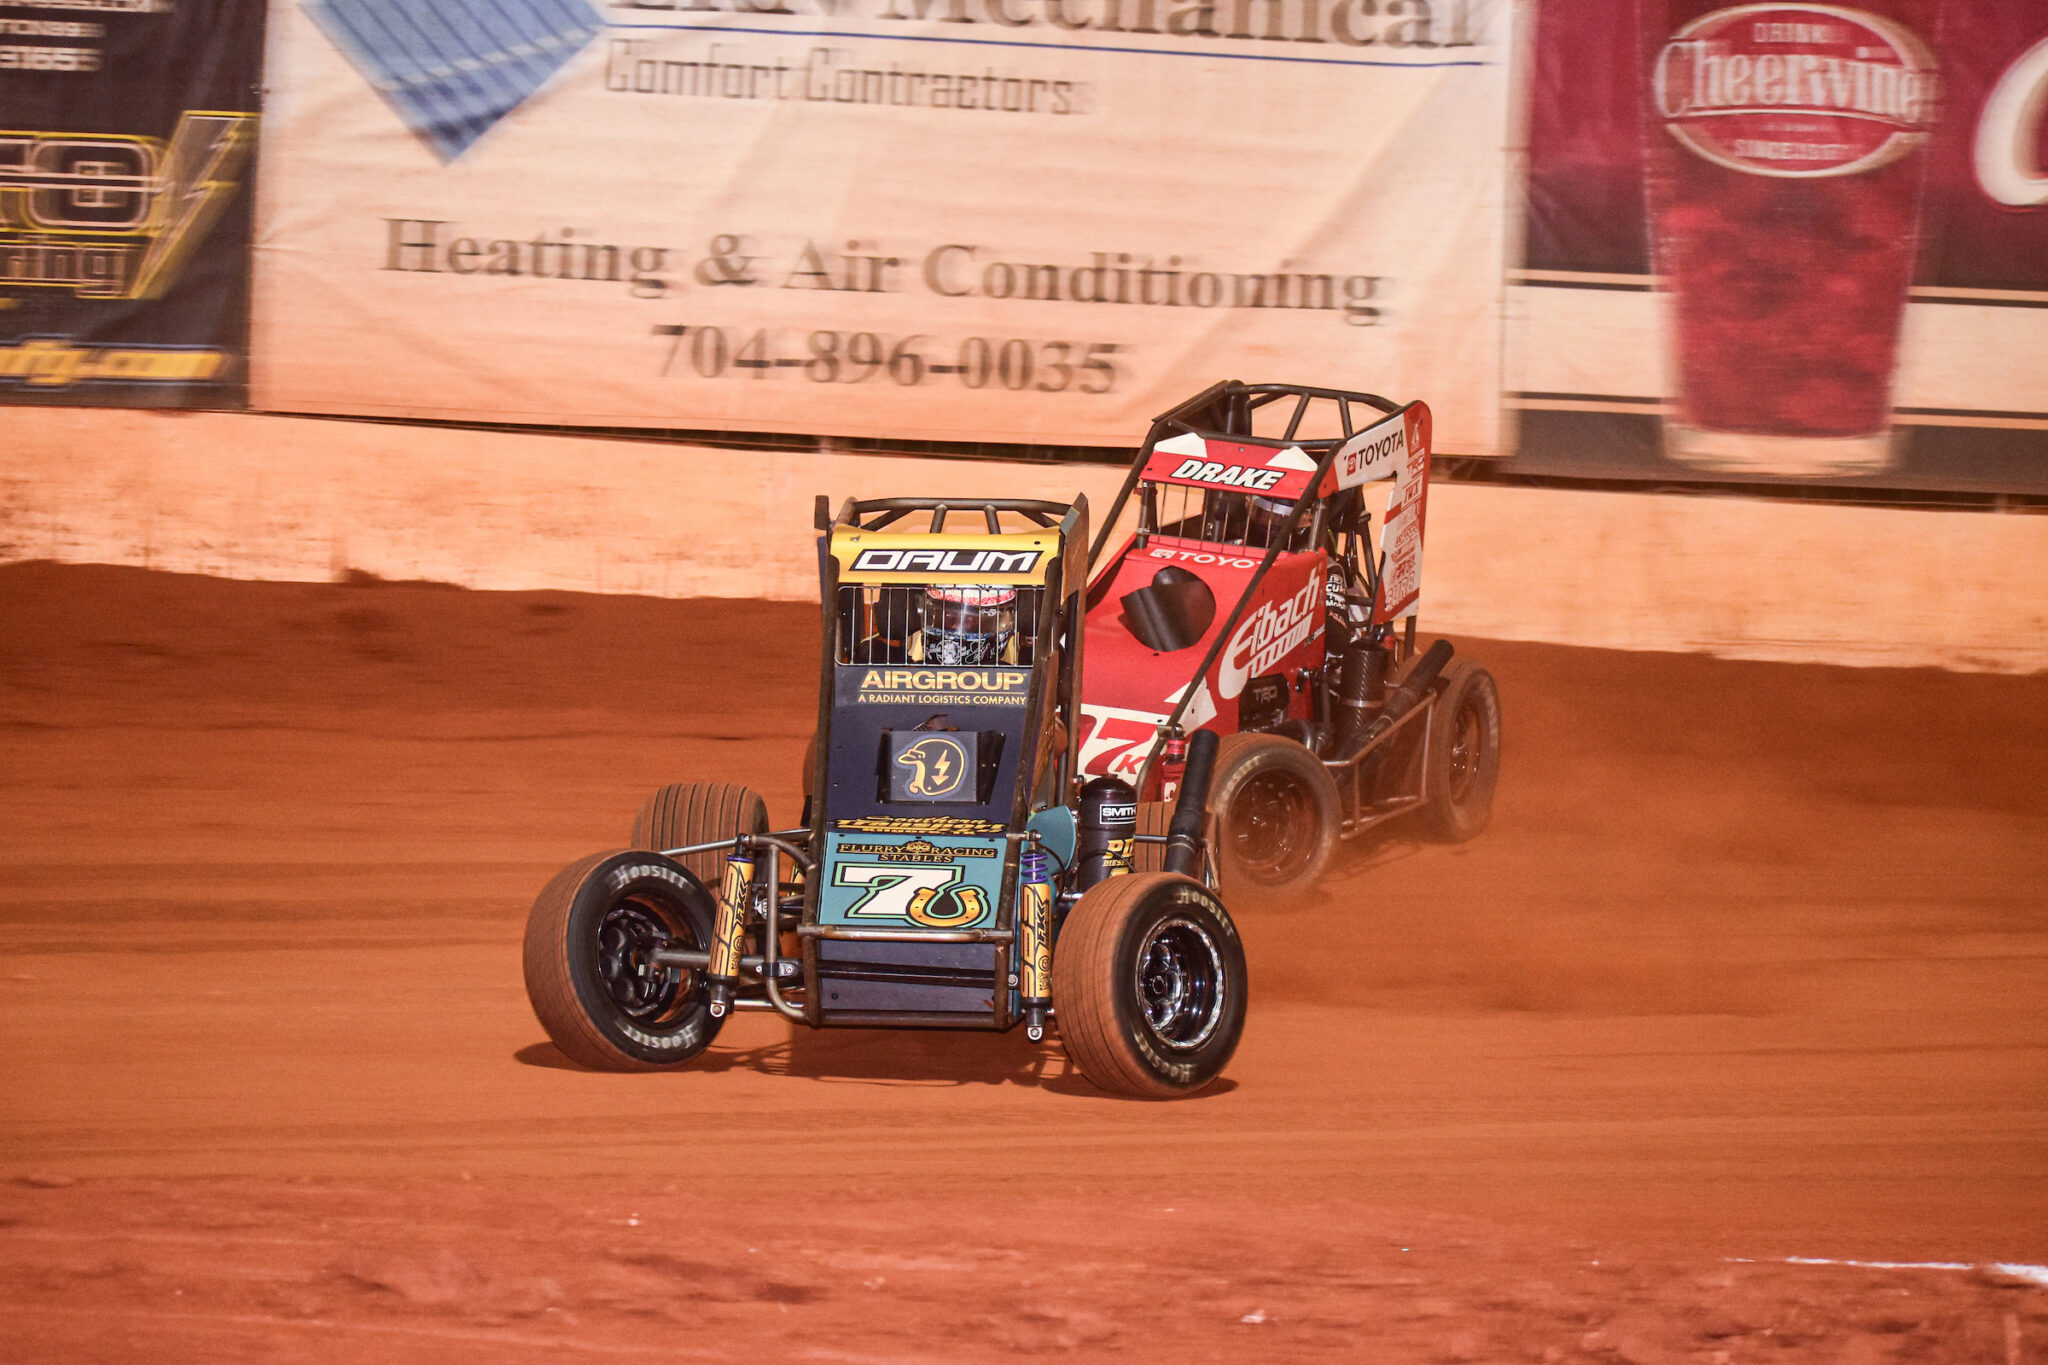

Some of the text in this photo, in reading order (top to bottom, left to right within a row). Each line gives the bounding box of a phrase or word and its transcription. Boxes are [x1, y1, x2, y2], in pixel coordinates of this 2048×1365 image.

[605, 38, 1082, 115] Comfort Contractors
[1654, 40, 1934, 123] Cheerwine
[380, 217, 1391, 326] Heating & Air Conditioning
[652, 323, 1134, 396] 704-896-0035
[1358, 429, 1404, 470] TOYOTA
[1172, 459, 1284, 491] DRAKE
[855, 551, 1038, 571] DAUM
[1180, 551, 1276, 569] TOYO
[1218, 567, 1320, 700] Eibach
[861, 670, 1024, 690] AIRGROUP
[858, 694, 1026, 705] A RADIANT LOGISTICS COMPANY
[840, 844, 996, 857] FLURRY RACING
[880, 853, 954, 863] STABLES
